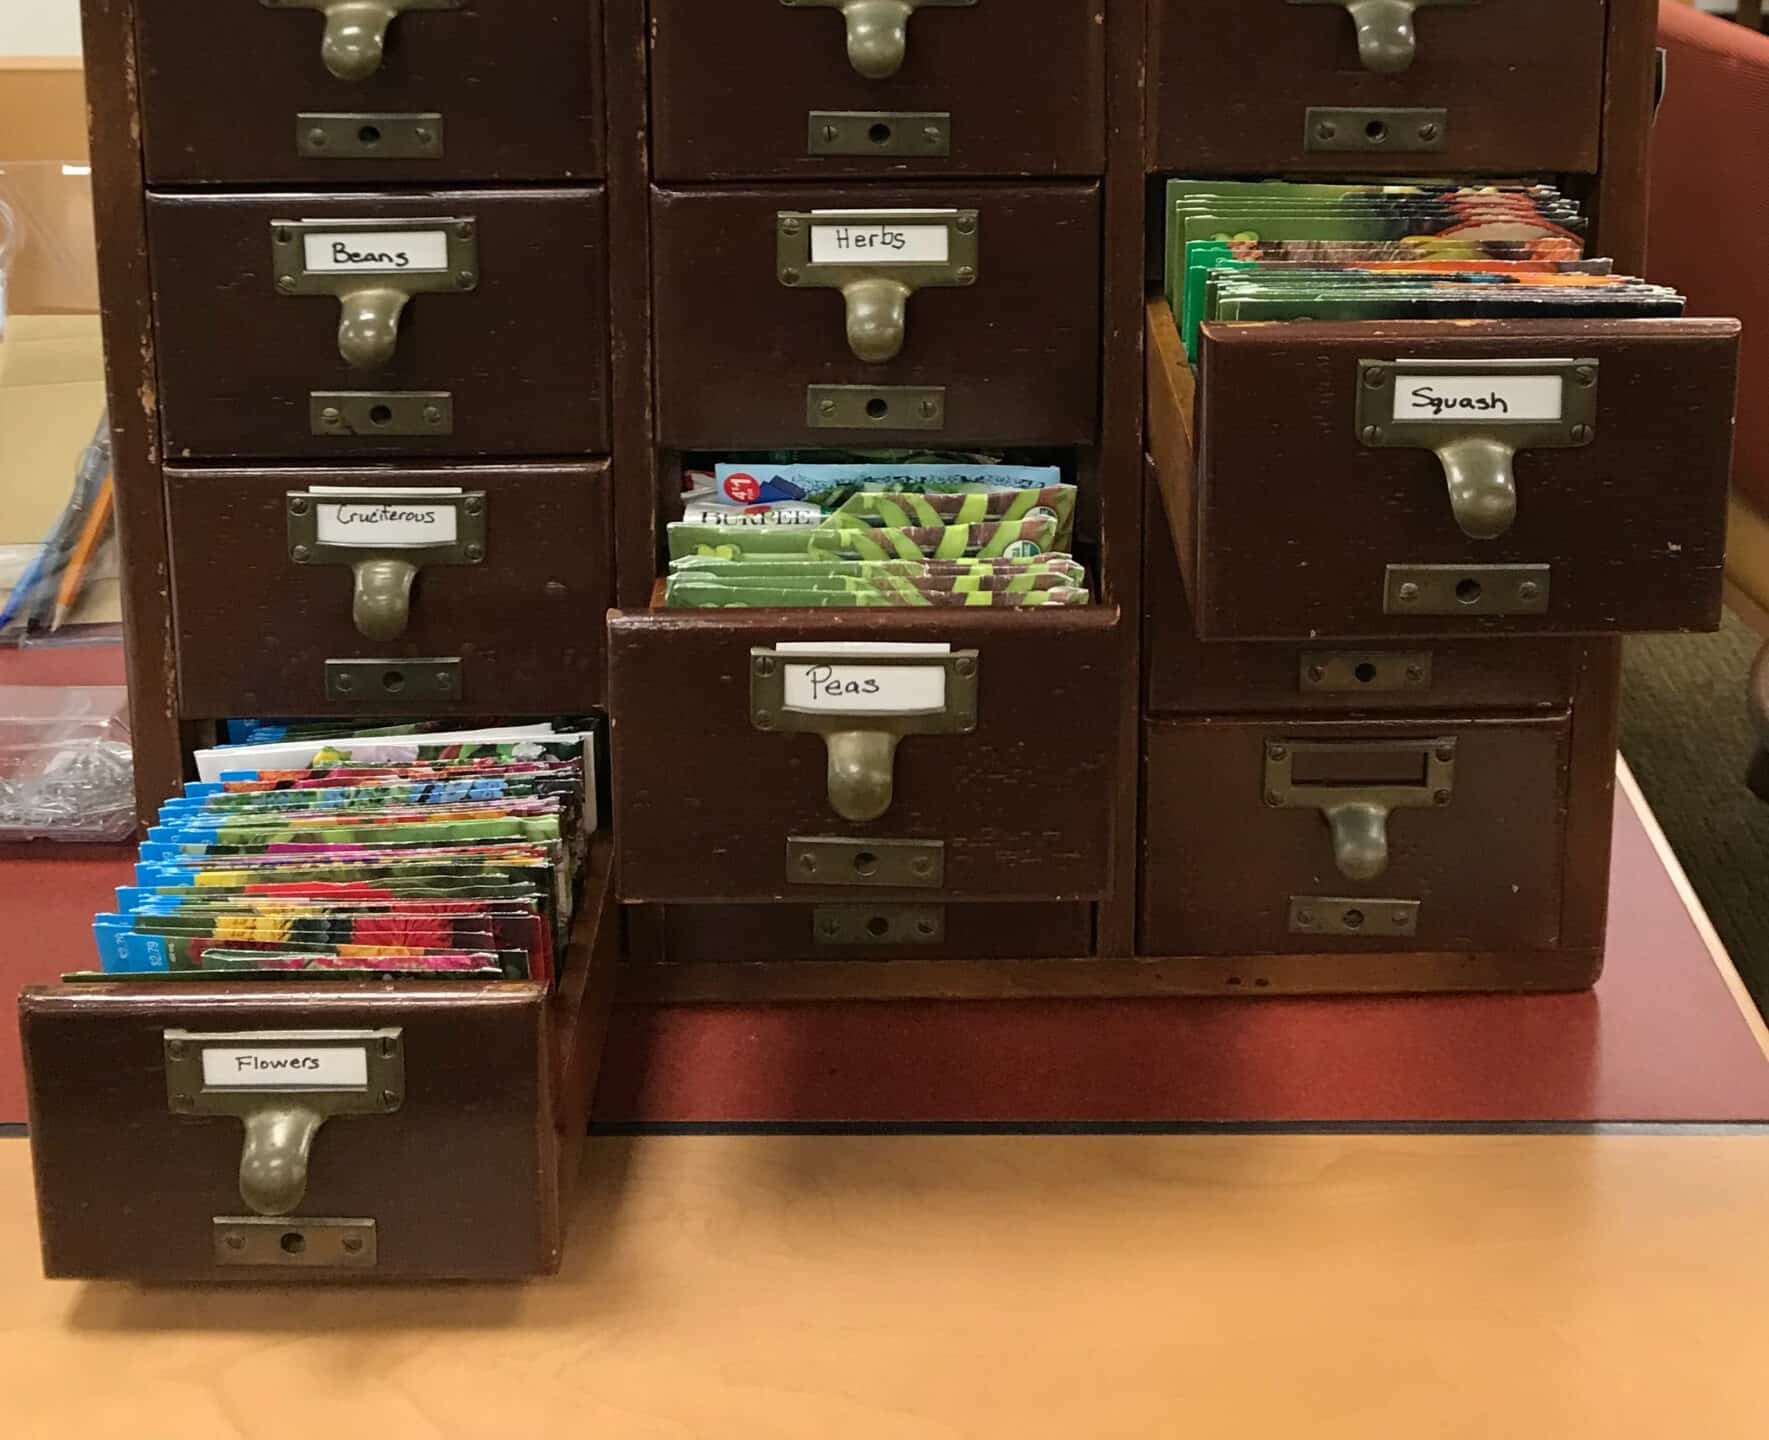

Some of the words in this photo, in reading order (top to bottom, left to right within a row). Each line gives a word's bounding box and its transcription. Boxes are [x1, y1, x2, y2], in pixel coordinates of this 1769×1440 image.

[836, 224, 905, 249] Herbs
[332, 241, 409, 267] Beans
[1411, 387, 1508, 415] Squash
[806, 664, 880, 700] Peas
[235, 1055, 320, 1072] Flowers
